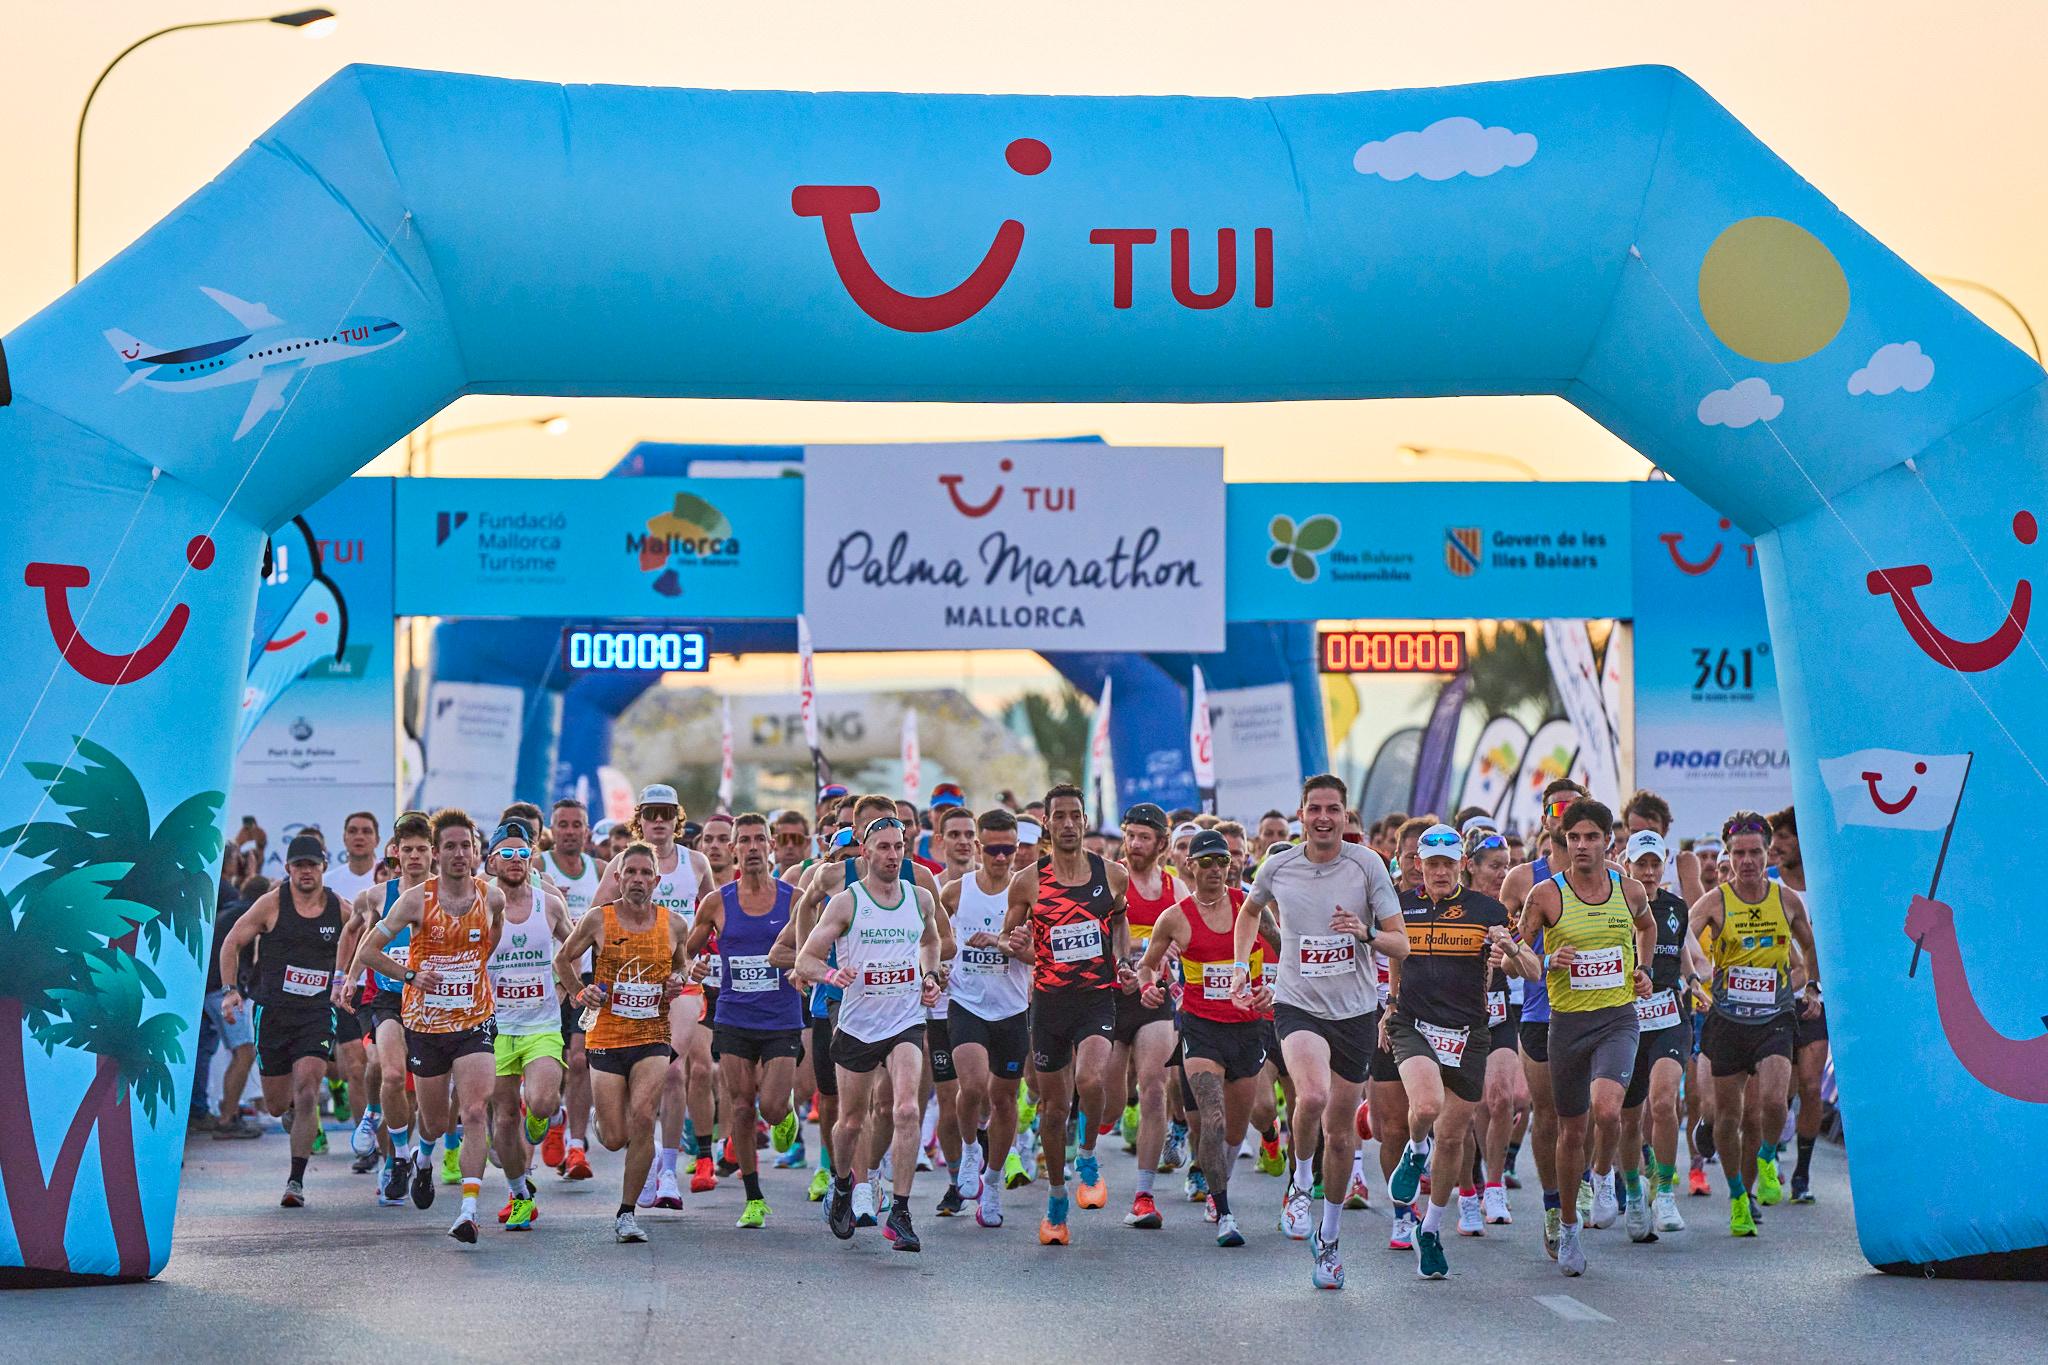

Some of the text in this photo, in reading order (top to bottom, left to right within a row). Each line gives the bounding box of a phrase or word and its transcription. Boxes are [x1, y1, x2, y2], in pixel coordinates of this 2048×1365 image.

[1089, 227, 1275, 310] TUI
[340, 326, 369, 344] TUI
[1023, 486, 1075, 511] TUI
[478, 511, 567, 530] Fundació
[478, 533, 561, 551] Mallorca
[626, 532, 740, 556] Mallorca
[1492, 530, 1607, 548] Govern de les
[315, 539, 364, 563] TUI
[1330, 552, 1359, 564] Illes
[479, 553, 556, 571] Turisme
[828, 526, 1202, 596] Palma Marathon
[1492, 553, 1598, 569] Illes Balears
[944, 606, 1086, 629] MALLORCA
[319, 926, 335, 934] UVU
[1749, 920, 1778, 928] Marathon
[860, 928, 905, 938] HEATON
[1408, 932, 1473, 947] ner Radkurier
[1058, 934, 1096, 951] 1216
[496, 950, 543, 963] HEATON
[967, 951, 1005, 965] 1035
[1307, 947, 1350, 964] 2720
[505, 961, 535, 969] HARRIERS
[1576, 960, 1618, 978] 6622
[290, 971, 323, 986] 6709
[740, 967, 768, 981] 892
[870, 970, 910, 986] 5821
[502, 985, 539, 999] 5013
[1734, 979, 1771, 992] 6642
[618, 994, 656, 1008] 5850
